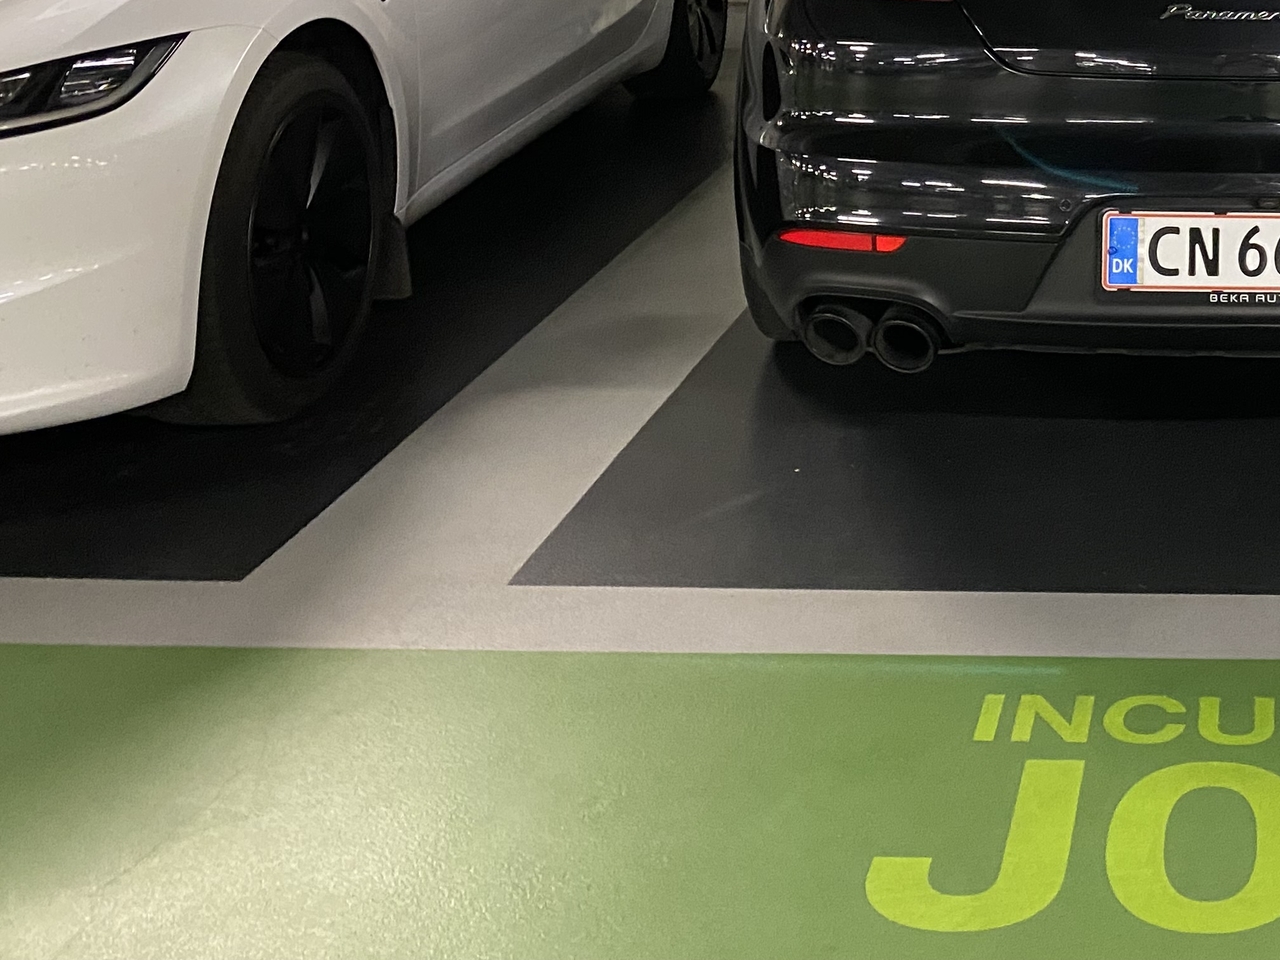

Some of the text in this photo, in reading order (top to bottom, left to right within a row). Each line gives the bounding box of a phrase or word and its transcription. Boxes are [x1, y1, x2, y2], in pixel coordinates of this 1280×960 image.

[1148, 226, 1220, 277] CN
[1112, 258, 1134, 274] DK
[1209, 293, 1250, 303] BEKA
